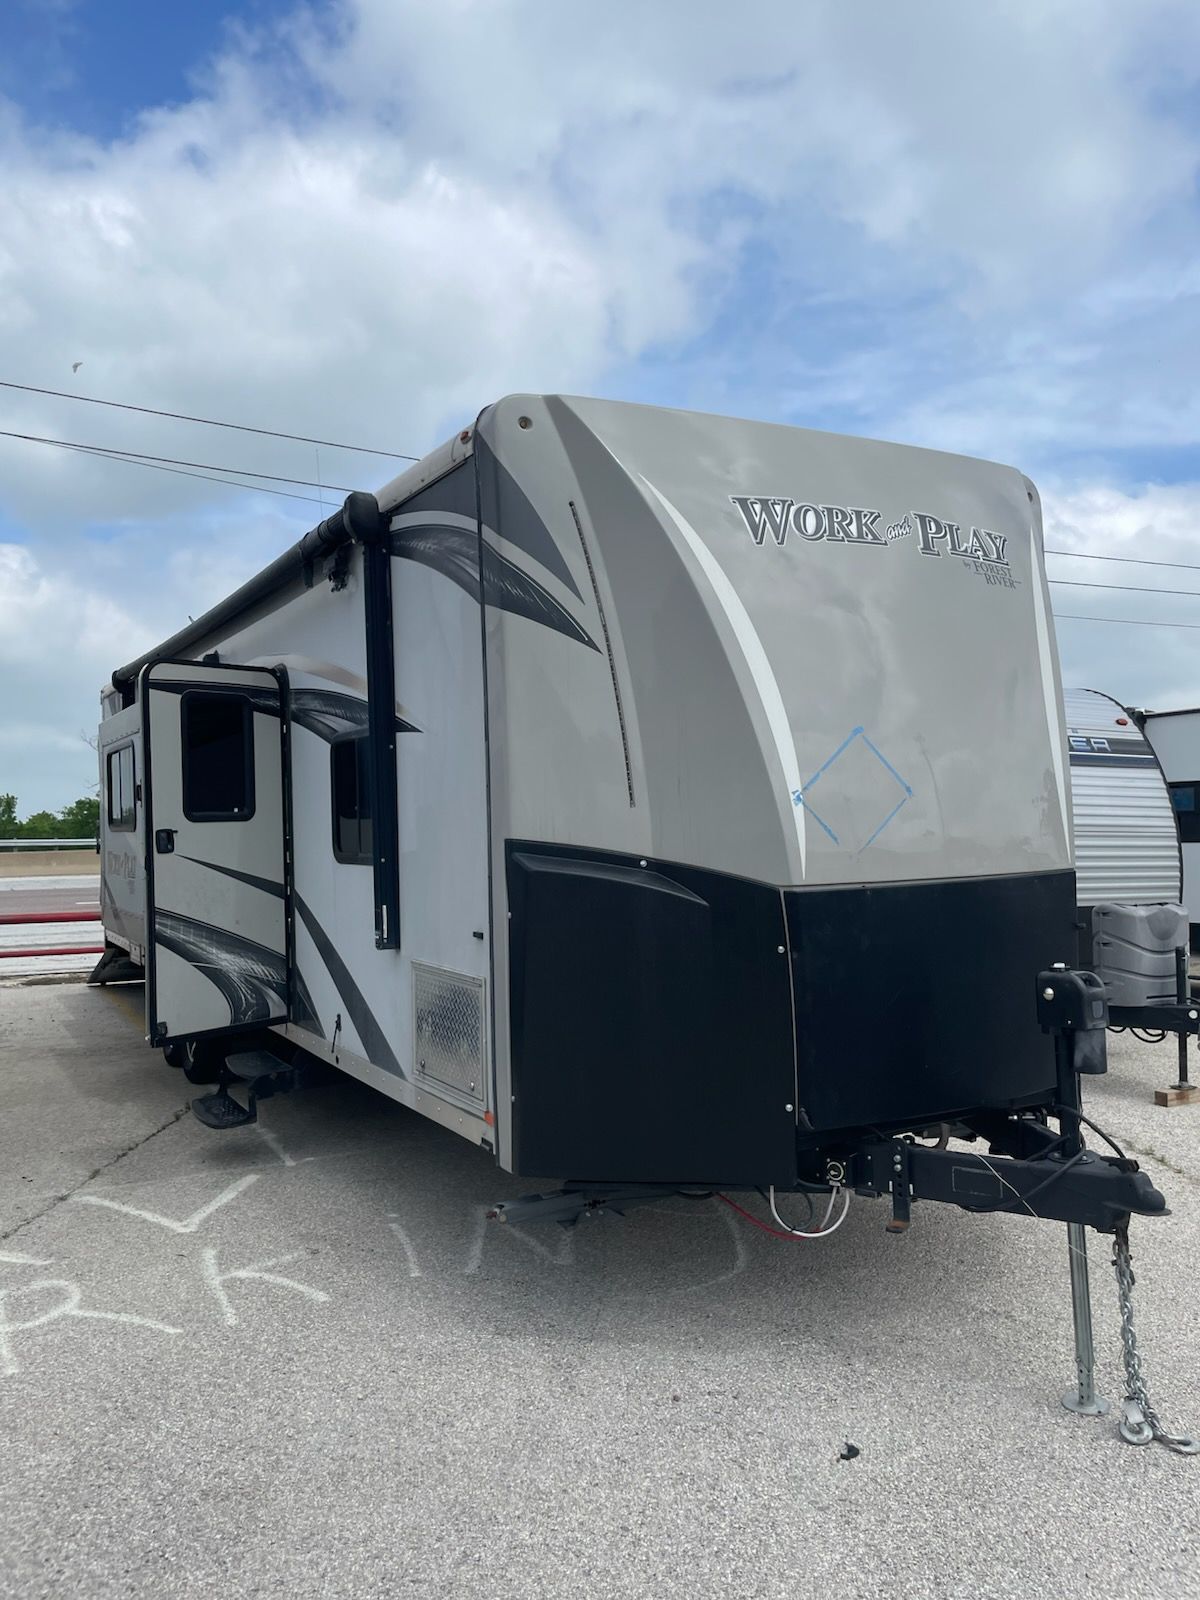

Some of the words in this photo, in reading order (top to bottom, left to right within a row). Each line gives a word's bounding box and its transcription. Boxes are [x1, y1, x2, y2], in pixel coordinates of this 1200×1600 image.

[729, 495, 889, 547] WORK
[886, 514, 912, 541] and
[910, 511, 1011, 568] PLAY
[972, 560, 1013, 578] FOREST
[984, 572, 1017, 590] RIVER
